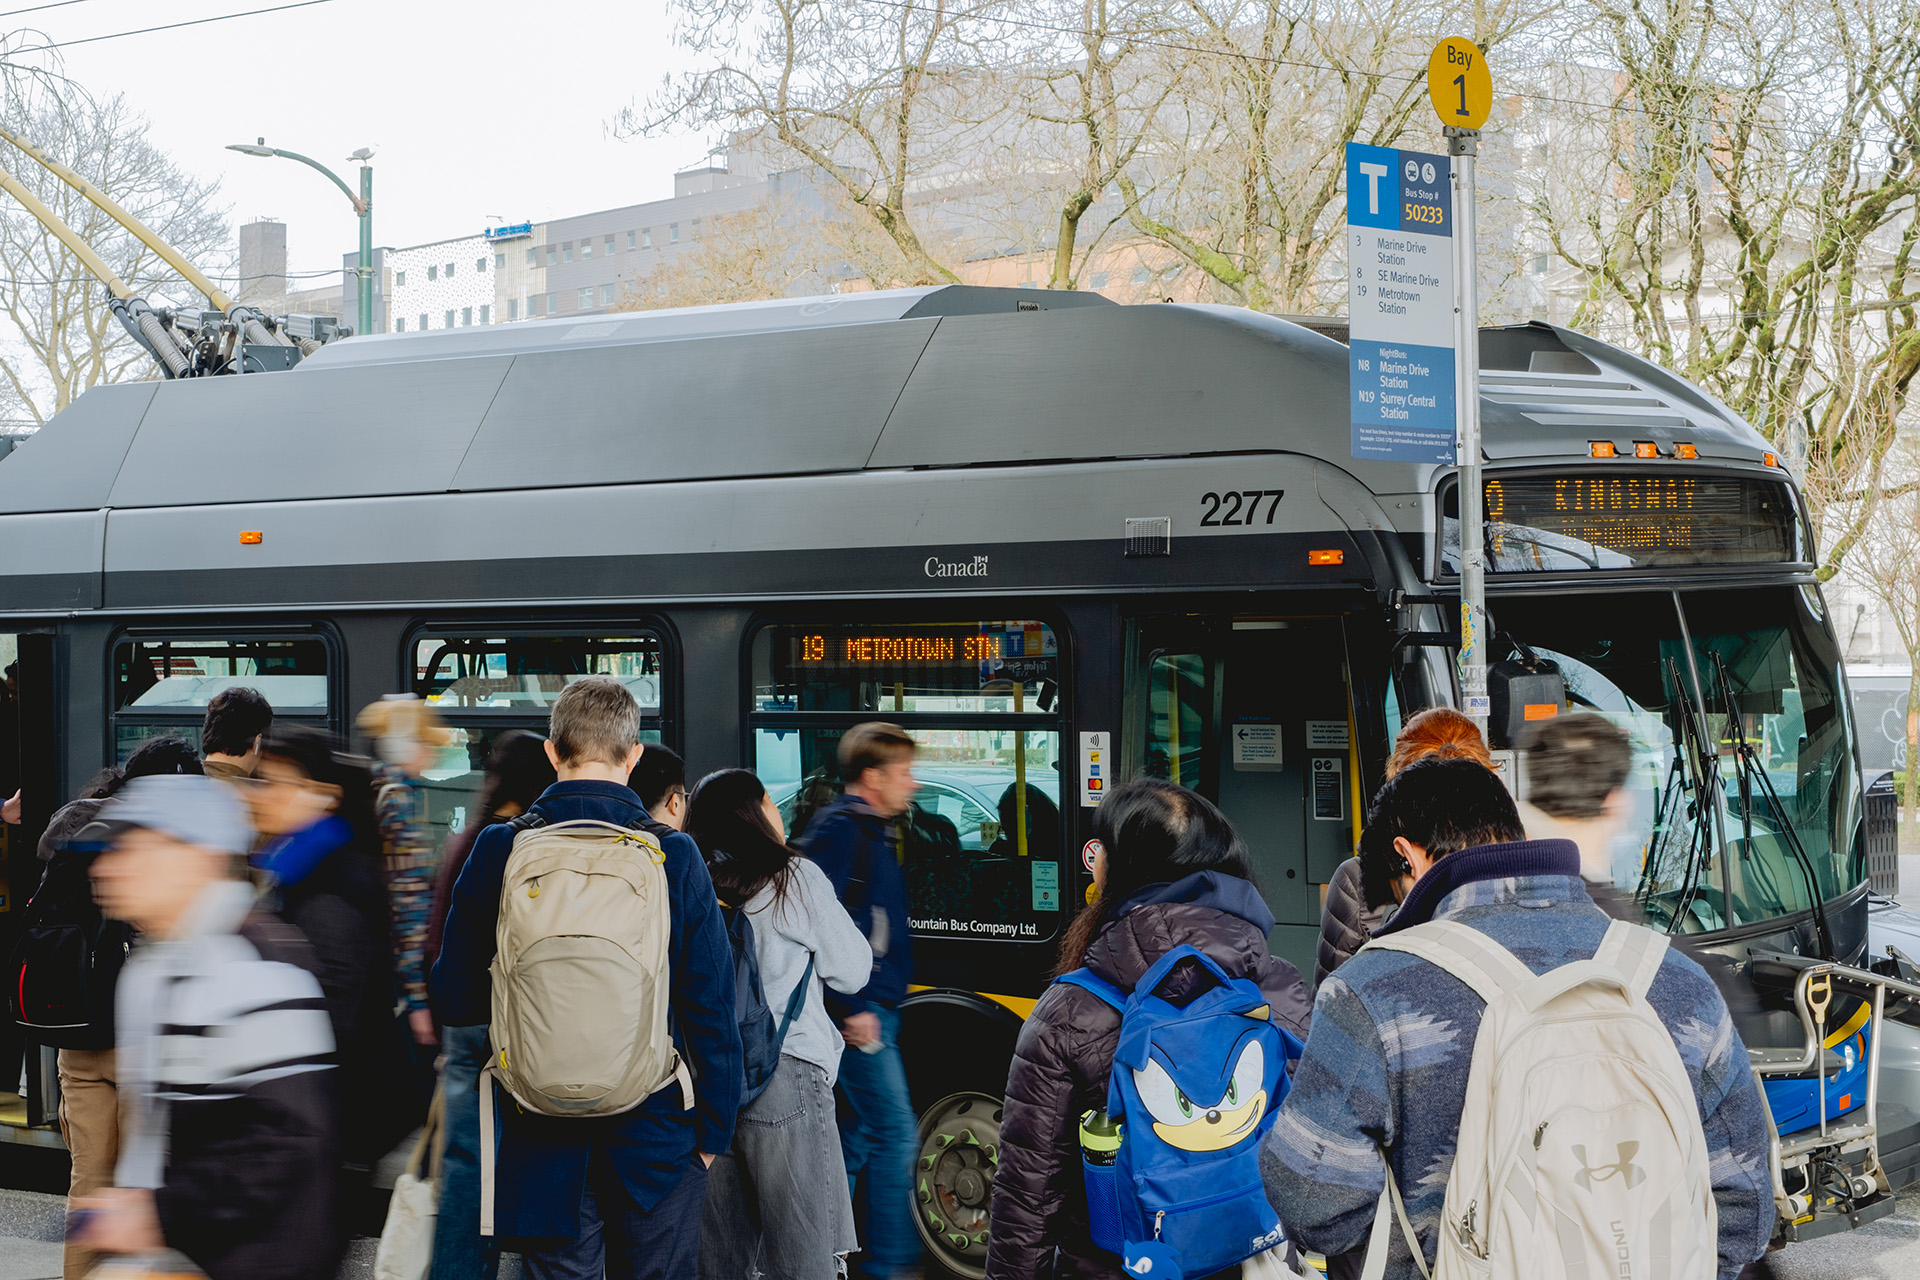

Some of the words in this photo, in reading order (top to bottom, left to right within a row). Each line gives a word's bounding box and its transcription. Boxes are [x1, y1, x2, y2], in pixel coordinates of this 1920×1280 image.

[1447, 45, 1473, 71] Bay
[1453, 74, 1470, 116] 1
[1359, 162, 1388, 214] T
[1405, 187, 1418, 198] Bus
[1418, 189, 1433, 202] Stop
[1434, 191, 1439, 200] #
[1405, 203, 1444, 224] 50233
[1356, 235, 1362, 247] 3
[1377, 237, 1405, 252] Marine
[1406, 240, 1427, 255] Drive
[1377, 251, 1406, 266] Station
[1356, 267, 1363, 279] 8
[1378, 269, 1388, 282] SE
[1390, 271, 1418, 285] Marine
[1419, 273, 1440, 288] Drive
[1357, 284, 1367, 297] 19
[1378, 286, 1421, 302] Metrotown
[1378, 301, 1407, 315] Station
[1379, 348, 1408, 360] NightBus:
[1358, 359, 1370, 372] N8
[1379, 360, 1408, 375] Marine
[1408, 363, 1430, 377] Drive
[1380, 375, 1409, 389] Station
[1358, 390, 1375, 404] N19
[1380, 392, 1407, 408] Surrey
[1407, 394, 1436, 408] Central
[1380, 406, 1409, 420] Station
[1556, 480, 1695, 510] KINGSWAY
[1200, 489, 1285, 527] 2277
[924, 555, 989, 578] Canada
[802, 635, 825, 661] 19
[847, 637, 954, 661] METROTOWN
[963, 636, 1000, 661] STN
[950, 919, 968, 932] Bus
[970, 920, 1017, 938] Company
[1020, 923, 1039, 936] Ltd.
